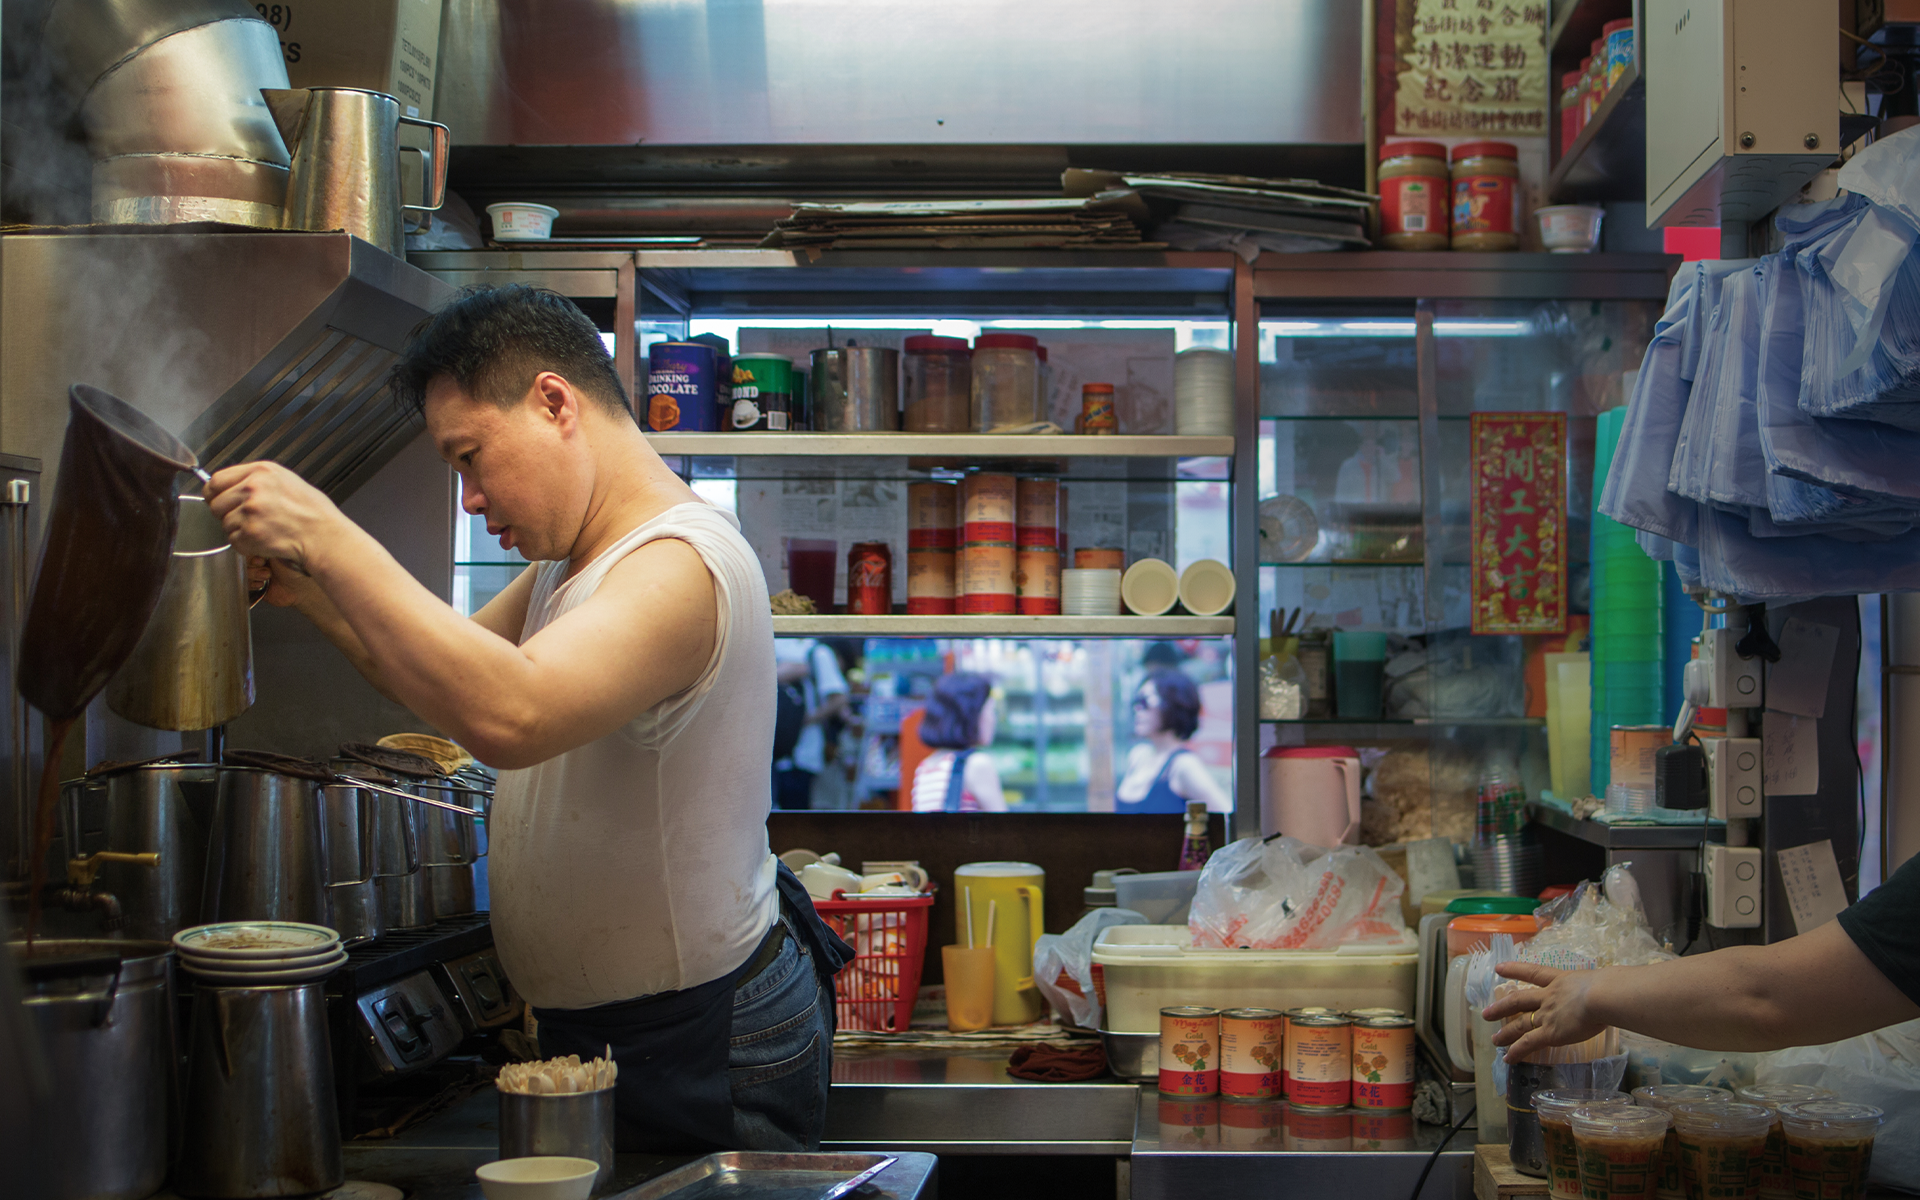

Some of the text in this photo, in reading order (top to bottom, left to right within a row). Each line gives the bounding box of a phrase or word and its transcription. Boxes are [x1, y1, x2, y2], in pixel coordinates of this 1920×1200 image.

[279, 41, 301, 64] S
[1418, 40, 1527, 69] 清潔運動
[1503, 445, 1535, 600] 開工大吉
[1185, 1032, 1204, 1040] Gold
[1361, 1042, 1378, 1051] Gold
[1182, 1073, 1206, 1085] 金花
[1359, 1084, 1381, 1098] 金花
